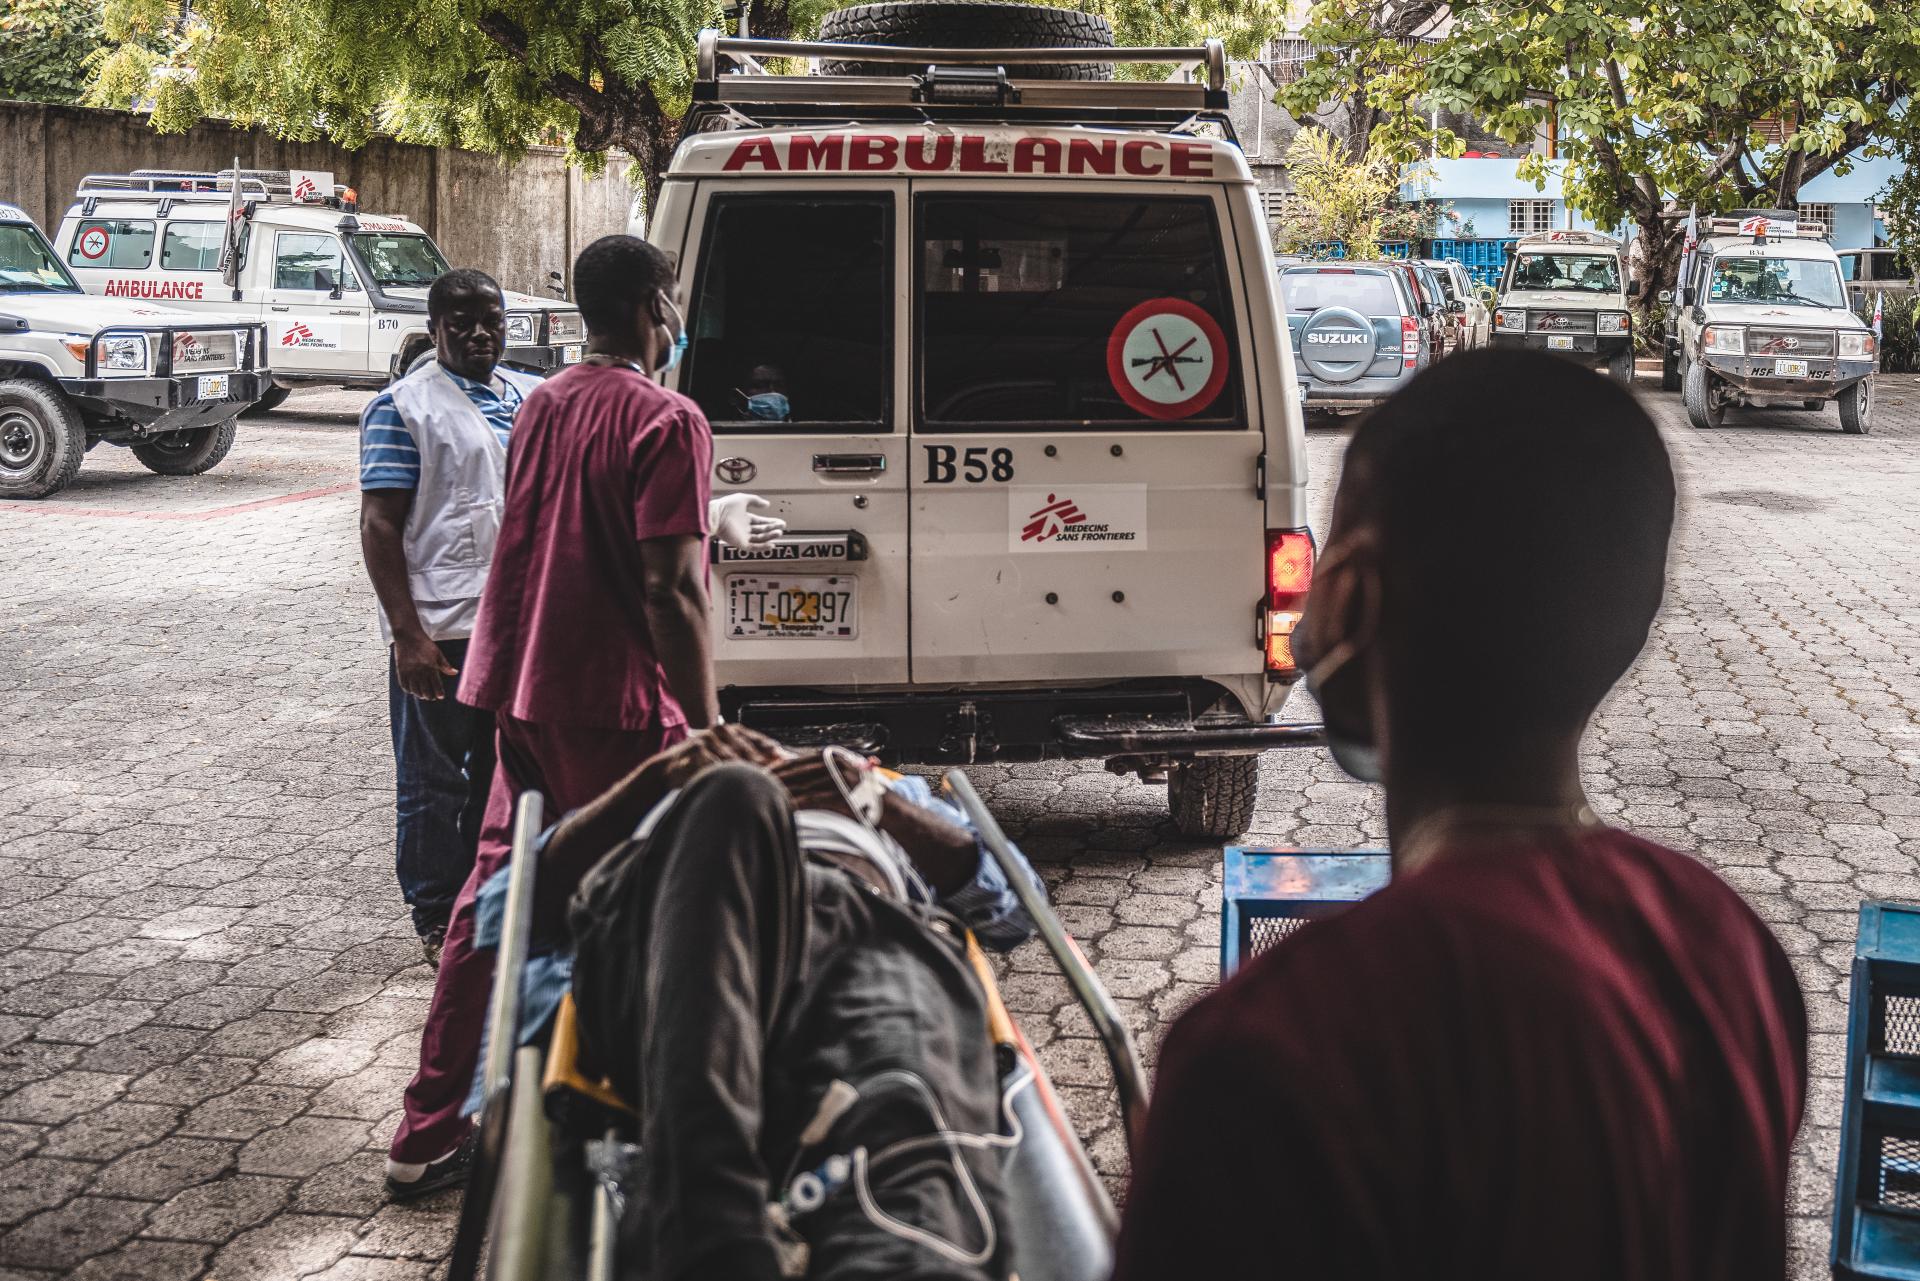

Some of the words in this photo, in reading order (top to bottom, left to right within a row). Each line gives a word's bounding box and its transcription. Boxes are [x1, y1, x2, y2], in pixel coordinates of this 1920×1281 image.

[722, 135, 1214, 177] AMBULANCE
[104, 279, 204, 300] AMBULANCE
[378, 320, 398, 330] B70
[1307, 333, 1368, 344] SUZUKI
[185, 347, 210, 355] MEDENS
[1751, 367, 1775, 377] MSF
[1807, 369, 1831, 379] MSF
[923, 444, 1014, 484] B58
[1063, 524, 1109, 533] MEDECINS
[1056, 533, 1079, 542] SANS
[1080, 532, 1136, 541] FRONTIERES
[801, 544, 846, 558] 4WD
